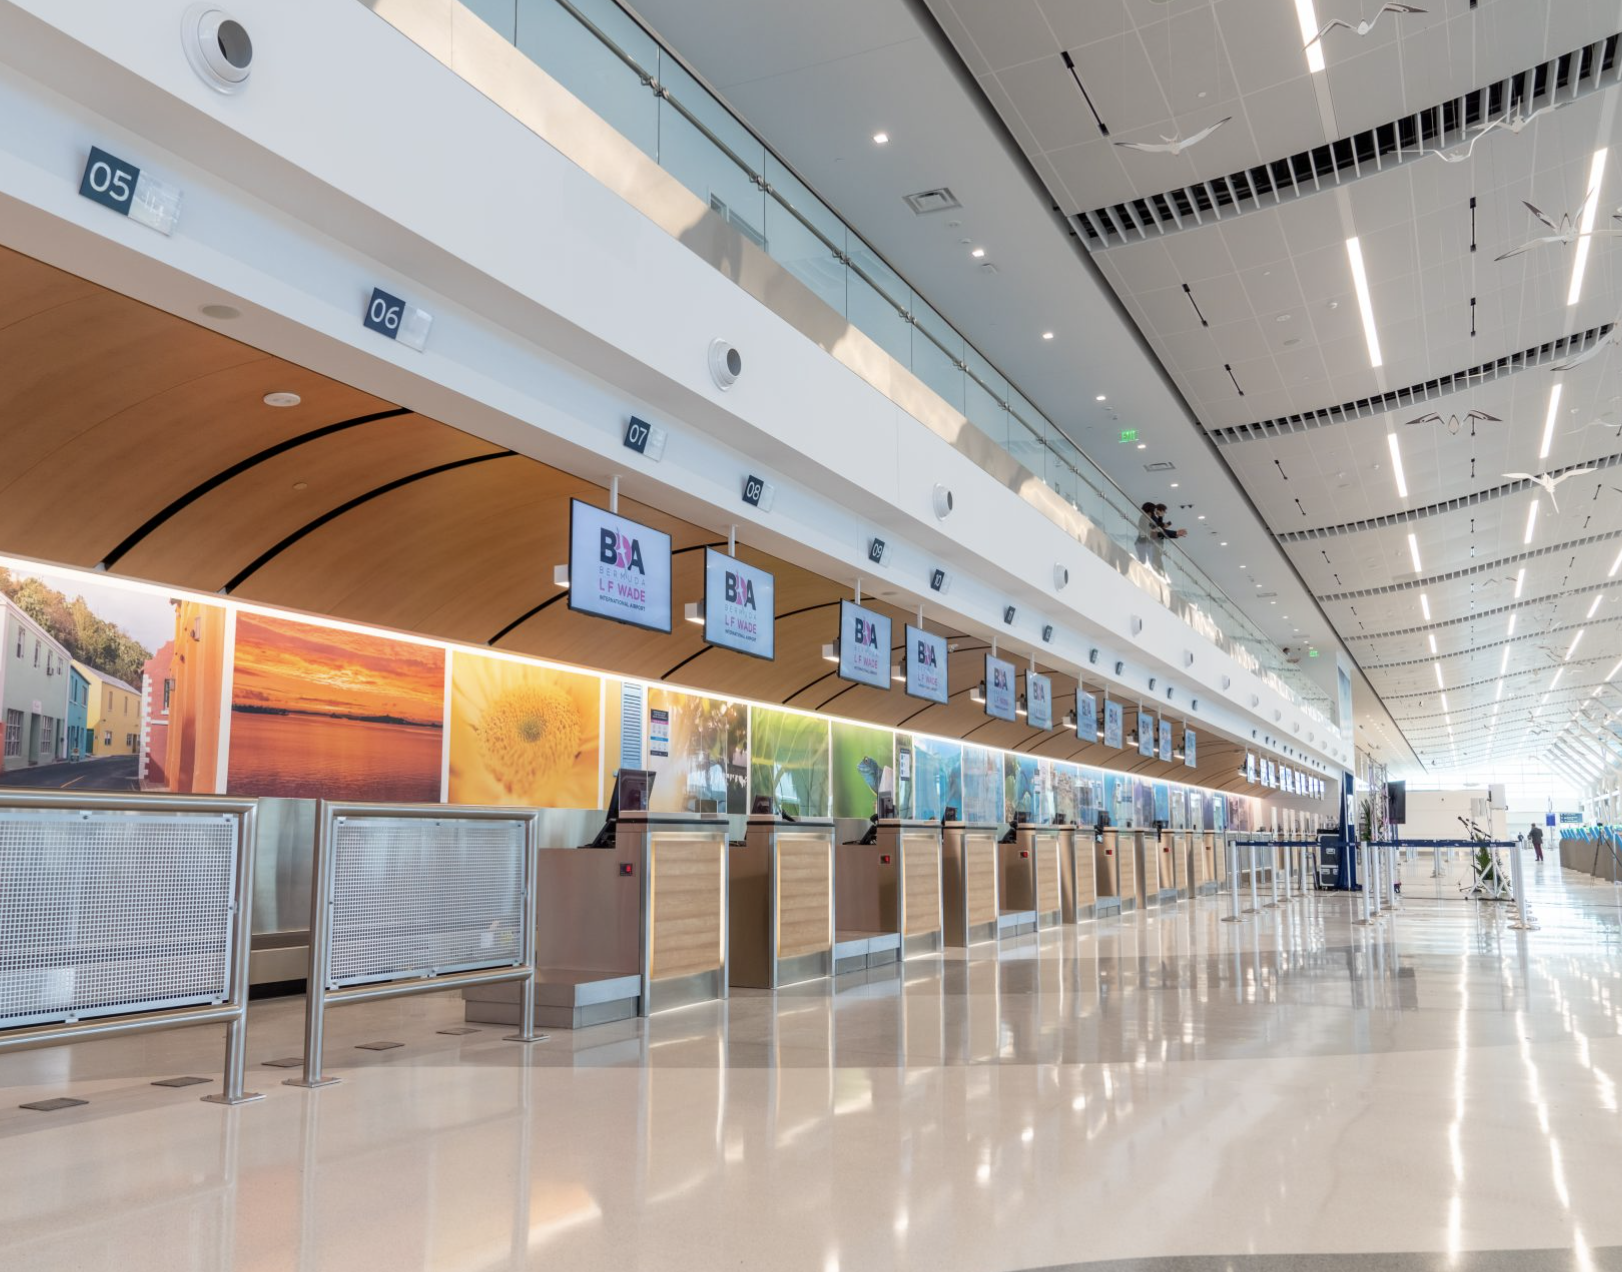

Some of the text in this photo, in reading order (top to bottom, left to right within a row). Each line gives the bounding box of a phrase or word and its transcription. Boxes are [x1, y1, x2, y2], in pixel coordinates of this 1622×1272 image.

[90, 161, 132, 201] 05
[371, 298, 400, 329] 06
[630, 424, 648, 446] 07
[747, 481, 761, 500] 08
[872, 543, 883, 558] 09
[599, 565, 646, 587] BERMUDA
[599, 577, 646, 604] L F WADE
[737, 618, 757, 636] WADE
